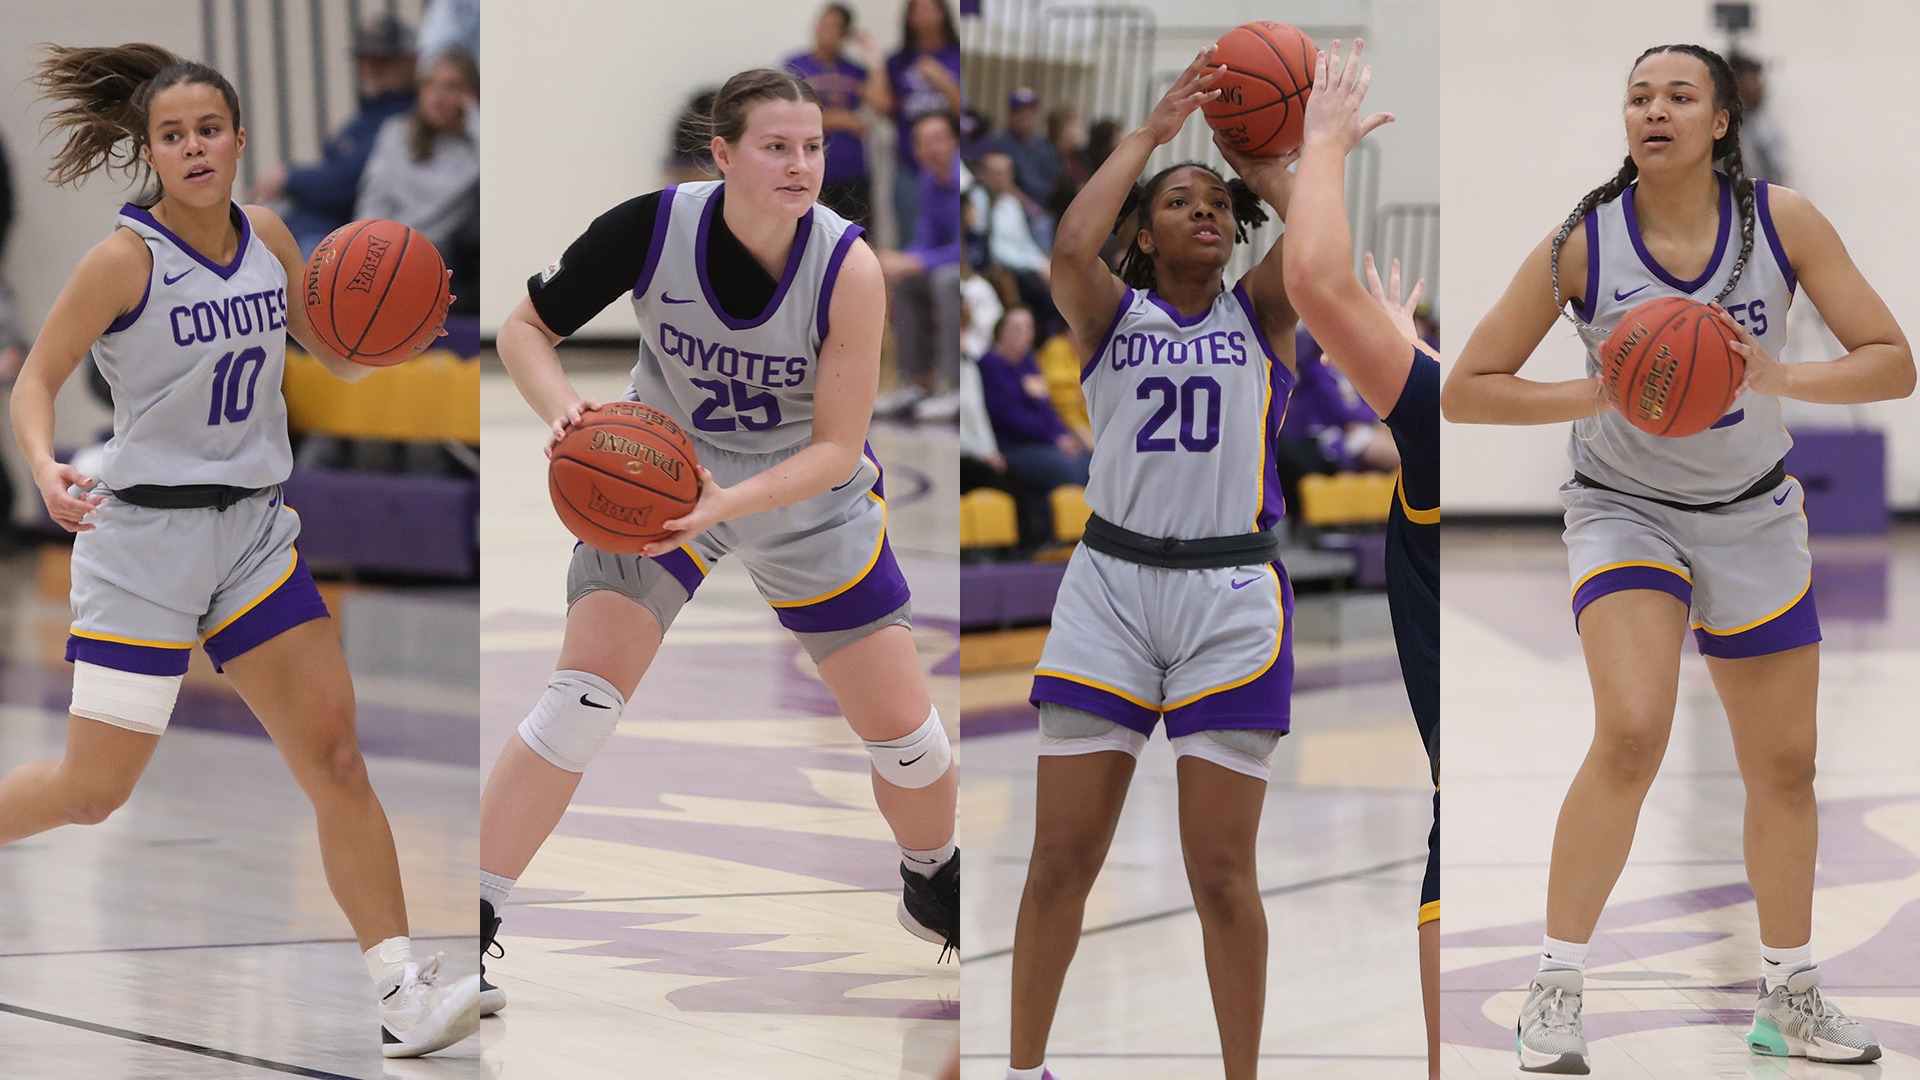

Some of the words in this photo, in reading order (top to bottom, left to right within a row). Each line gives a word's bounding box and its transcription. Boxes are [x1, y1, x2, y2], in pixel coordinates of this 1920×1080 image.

[344, 235, 392, 294] NAIA
[169, 287, 287, 347] COYOTES
[660, 322, 808, 388] COYOTES
[1112, 331, 1247, 372] COYOTES
[207, 345, 267, 426] 10
[689, 377, 782, 432] 25
[1637, 344, 1673, 421] LEGACY
[1136, 376, 1222, 453] 20
[589, 429, 685, 483] SPALDING
